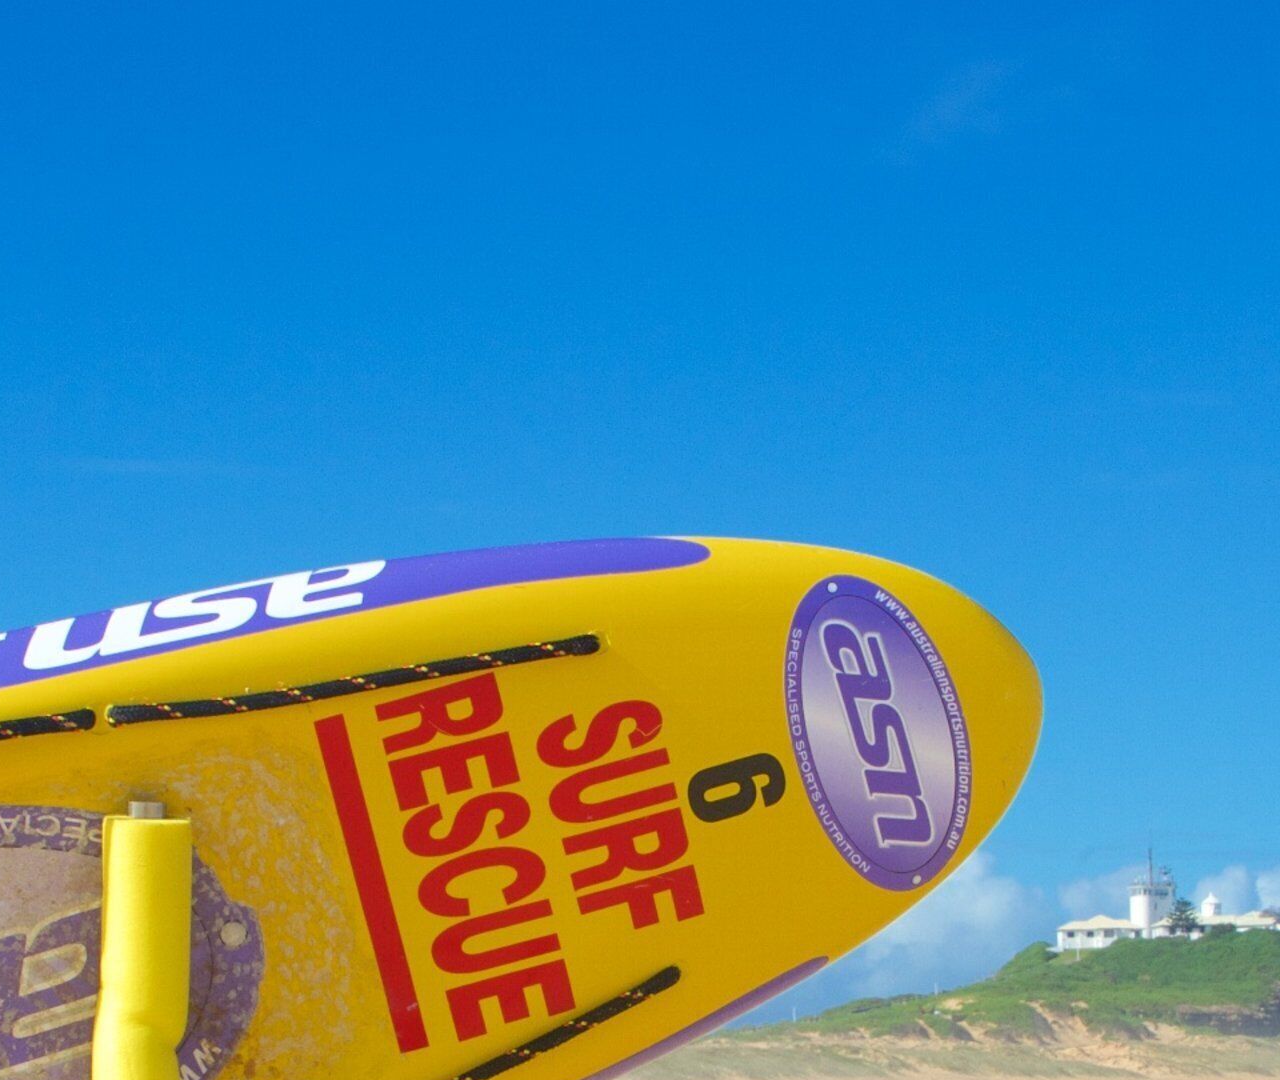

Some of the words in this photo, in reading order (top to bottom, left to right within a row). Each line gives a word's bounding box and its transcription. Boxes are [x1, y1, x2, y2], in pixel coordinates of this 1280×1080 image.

[786, 627, 803, 736] SPECIALISED
[819, 618, 936, 848] asn
[874, 589, 970, 850] www.australiansportsnutrition.com.au
[535, 699, 706, 930] SURF
[687, 752, 787, 824] 6
[794, 739, 821, 802] SPORTS
[817, 803, 871, 874] NUTRITION
[374, 671, 577, 1043] RESCUE
